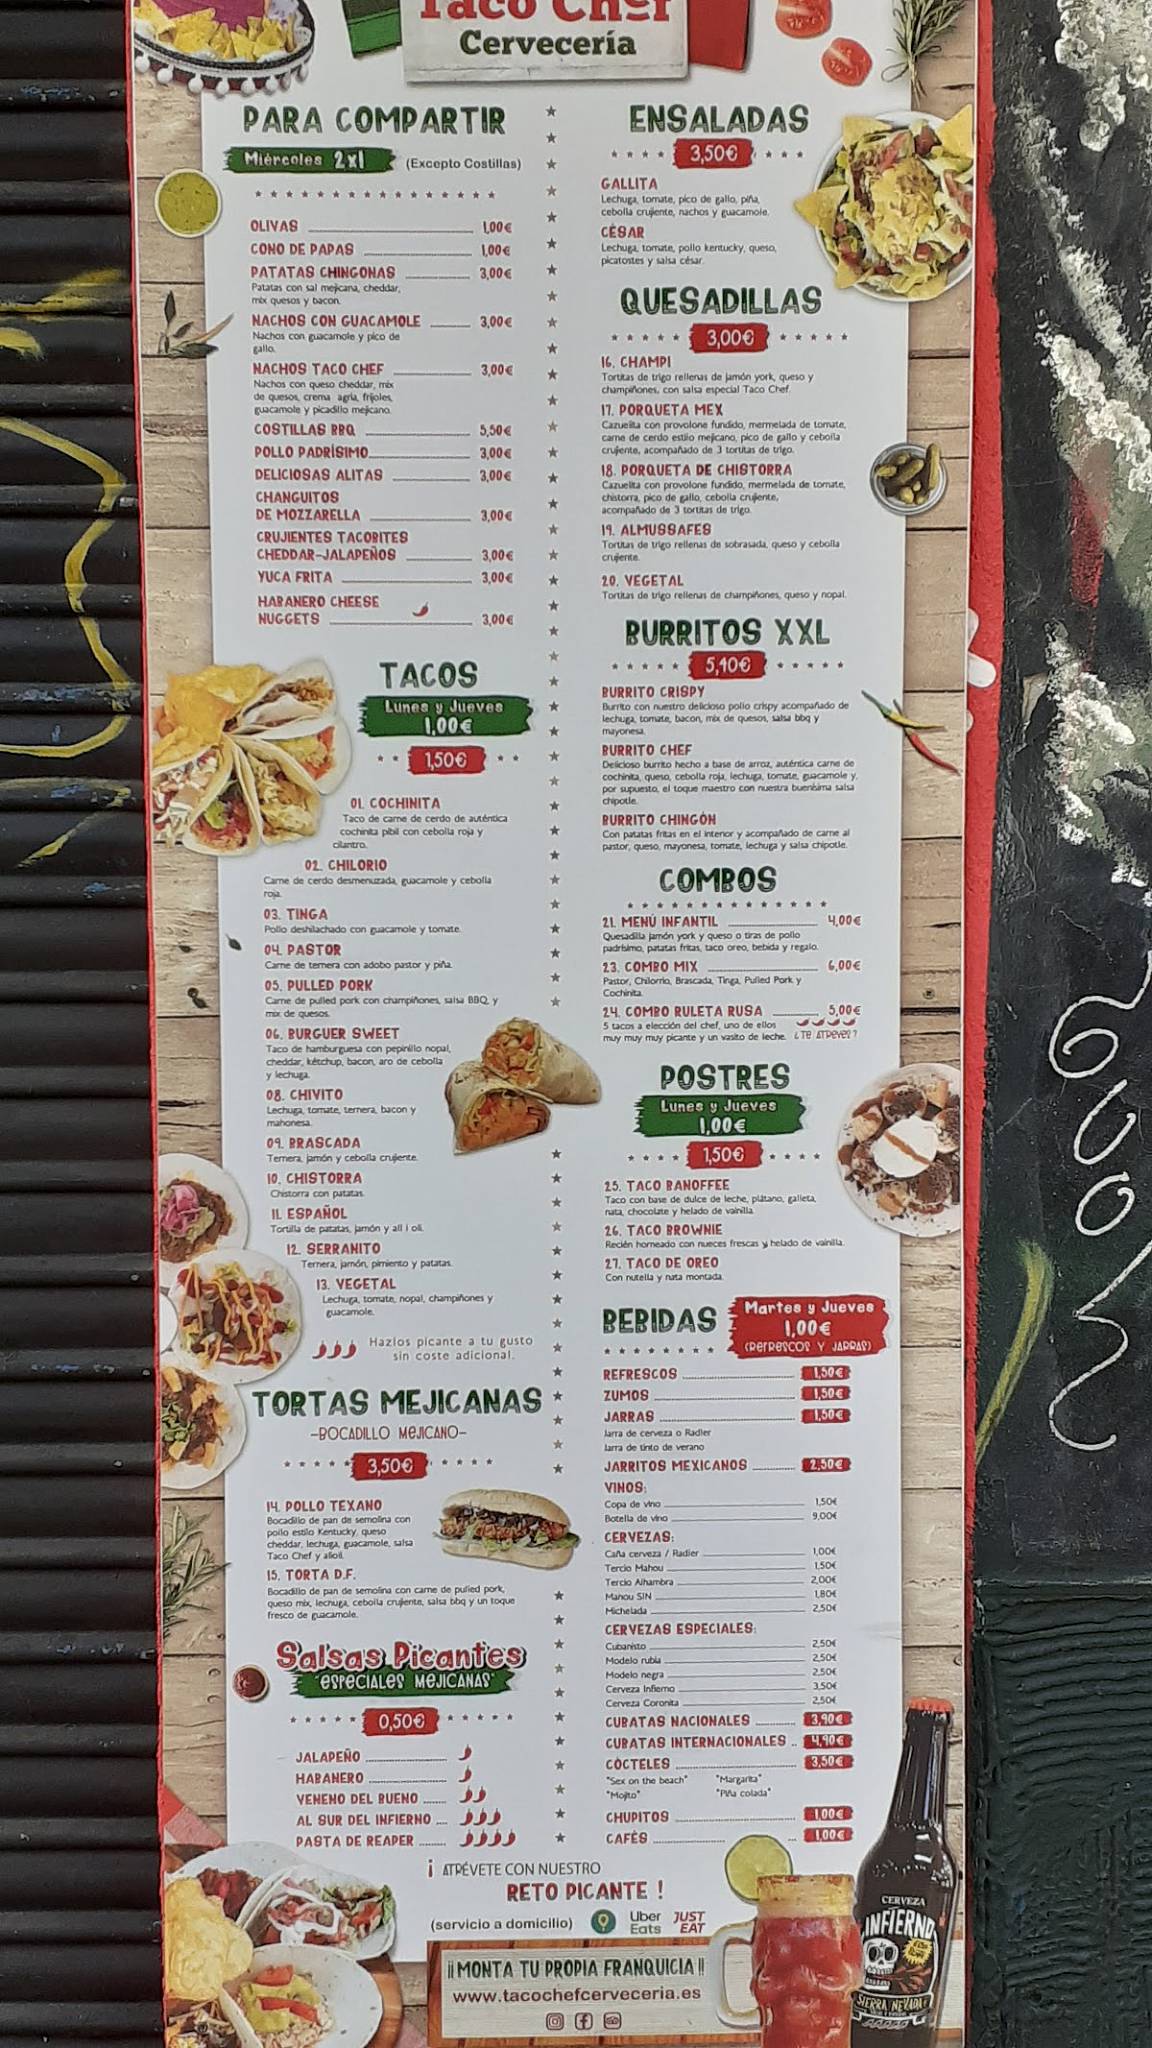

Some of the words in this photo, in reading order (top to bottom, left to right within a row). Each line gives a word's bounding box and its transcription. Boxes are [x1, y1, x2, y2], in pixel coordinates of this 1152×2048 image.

[460, 30, 636, 55] Cervecería
[244, 106, 322, 133] PARA
[336, 106, 505, 134] COMPARTIR
[630, 104, 808, 133] ENSALADAS
[245, 151, 321, 165] Miércoles
[335, 150, 364, 169] 2x1
[691, 144, 737, 164] 3,50€
[407, 158, 460, 171] (Excepto
[464, 158, 521, 170] Costillas)
[601, 177, 657, 190] GALLITA
[251, 220, 298, 232] OLIVAS
[483, 221, 511, 234] 1,00€
[601, 224, 644, 239] CÉSAR
[251, 243, 284, 255] CONO
[290, 243, 305, 255] DE
[310, 243, 353, 256] PAPAS
[482, 244, 510, 257] 1,00€
[251, 266, 314, 278] PATATAS
[320, 266, 395, 279] CHINGONAS
[480, 267, 511, 280] 3,00€
[621, 286, 821, 315] QUESADILLAS
[252, 315, 306, 327] NACHOS
[311, 315, 336, 327] CON
[341, 315, 420, 327] GUACAMOLE
[481, 316, 512, 329] 3,00€
[253, 331, 285, 340] Nachos
[309, 332, 355, 342] guacamole
[358, 334, 364, 342] y
[367, 332, 385, 342] pico
[708, 329, 754, 349] 3,00€
[602, 356, 615, 369] 16.
[621, 356, 670, 368] CHAMPI
[253, 363, 306, 375] NACHOS
[312, 363, 347, 375] TACO
[352, 363, 384, 375] CHEF
[481, 364, 512, 377] 3,00€
[255, 423, 326, 436] COSTILLAS
[331, 424, 355, 436] BBQ
[480, 424, 511, 437] 5,50€
[255, 468, 330, 481] DELICIOSAS
[336, 469, 382, 481] ALITAS
[480, 470, 511, 483] 3,00€
[626, 618, 761, 646] BURRITOS
[775, 619, 830, 645] XXL
[380, 661, 477, 688] TACOS
[386, 700, 428, 713] Lunes
[436, 703, 443, 714] y
[450, 699, 503, 713] Jueves
[425, 717, 472, 735] 1,00€
[602, 744, 654, 756] BURRITO
[660, 744, 692, 756] CHEF
[425, 752, 466, 770] 1,50€
[370, 797, 440, 809] COCHINITA
[603, 814, 654, 826] BURRITO
[660, 812, 716, 825] CHINGÓN
[660, 866, 776, 893] COMBOS
[264, 909, 280, 920] 03.
[287, 908, 328, 920] TINGA
[621, 915, 656, 928] MENÚ
[662, 916, 718, 927] INFANTIL
[828, 915, 860, 927] 4,00€
[265, 925, 287, 933] Pollo
[291, 925, 346, 933] deshilachado
[370, 925, 416, 935] guacamole
[420, 927, 425, 935] y
[603, 961, 620, 973] 23.
[625, 961, 668, 972] COMBO
[674, 961, 697, 972] MIX
[829, 960, 860, 972] 6,00€
[265, 980, 282, 992] 05.
[288, 979, 334, 991] PULLED
[340, 980, 373, 991] PORK
[661, 1063, 789, 1090] POSTRES
[661, 1100, 703, 1112] Lunes
[710, 1103, 717, 1113] y
[724, 1099, 776, 1112] Jueves
[700, 1117, 746, 1135] 1,00€
[704, 1147, 744, 1165] 1,50€
[745, 1301, 801, 1314] Martes
[808, 1304, 815, 1314] y
[822, 1301, 874, 1313] Jueves
[603, 1306, 716, 1333] BEBIDAS
[784, 1320, 831, 1338] 1,00€
[370, 1337, 410, 1346] Hazlos
[416, 1338, 462, 1348] picante
[469, 1337, 474, 1346] a
[481, 1337, 493, 1345] tu
[499, 1337, 532, 1349] gusto
[394, 1351, 409, 1360] sin
[416, 1352, 449, 1360] coste
[456, 1350, 514, 1360] adicional.
[604, 1368, 677, 1380] REFRESCOS
[814, 1367, 843, 1378] 1,50€
[604, 1389, 648, 1401] ZUMOS
[814, 1388, 843, 1399] 1,50€
[252, 1389, 368, 1417] TORTAS
[381, 1387, 541, 1414] MEJICANAS
[368, 1458, 413, 1477] 3,50€
[605, 1460, 666, 1472] JARRITOS
[672, 1459, 747, 1471] MEXICANOS
[810, 1459, 843, 1471] 2,50€
[605, 1531, 673, 1543] CERVEZAS:
[277, 1641, 382, 1669] Salsas
[393, 1641, 524, 1669] Picantes
[379, 1712, 424, 1732] 0,50€
[606, 1716, 665, 1728] CUBATAS
[671, 1714, 750, 1727] NACIONALES
[810, 1713, 843, 1725] 3,90€
[296, 1748, 360, 1763] JALAPEÑO
[296, 1772, 363, 1784] HABANERO
[607, 1811, 668, 1823] CHUPITOS
[814, 1809, 844, 1821] 1,00€
[443, 1862, 501, 1876] ATRÉVETE
[504, 1863, 534, 1875] CON
[539, 1862, 600, 1875] NUESTRO
[507, 1883, 558, 1902] RETO
[566, 1881, 647, 1900] PICANTE
[882, 1896, 926, 1906] CERVEZA
[630, 1911, 661, 1922] Uber
[674, 1911, 705, 1923] JUST
[865, 1907, 935, 1939] INFIERNO
[431, 1919, 490, 1932] (servicio
[494, 1921, 502, 1929] a
[506, 1918, 572, 1930] domicilio)
[630, 1923, 661, 1934] Eats
[680, 1923, 705, 1933] EAT
[520, 1960, 539, 1978] TU
[546, 1959, 598, 1978] PROPIA
[604, 1958, 694, 1976] FRANQUICIA
[453, 1988, 700, 2003] www.tacochefcerveceria.es
[857, 1994, 888, 2012] SIERRA
[892, 1996, 922, 2011] NEVADA
